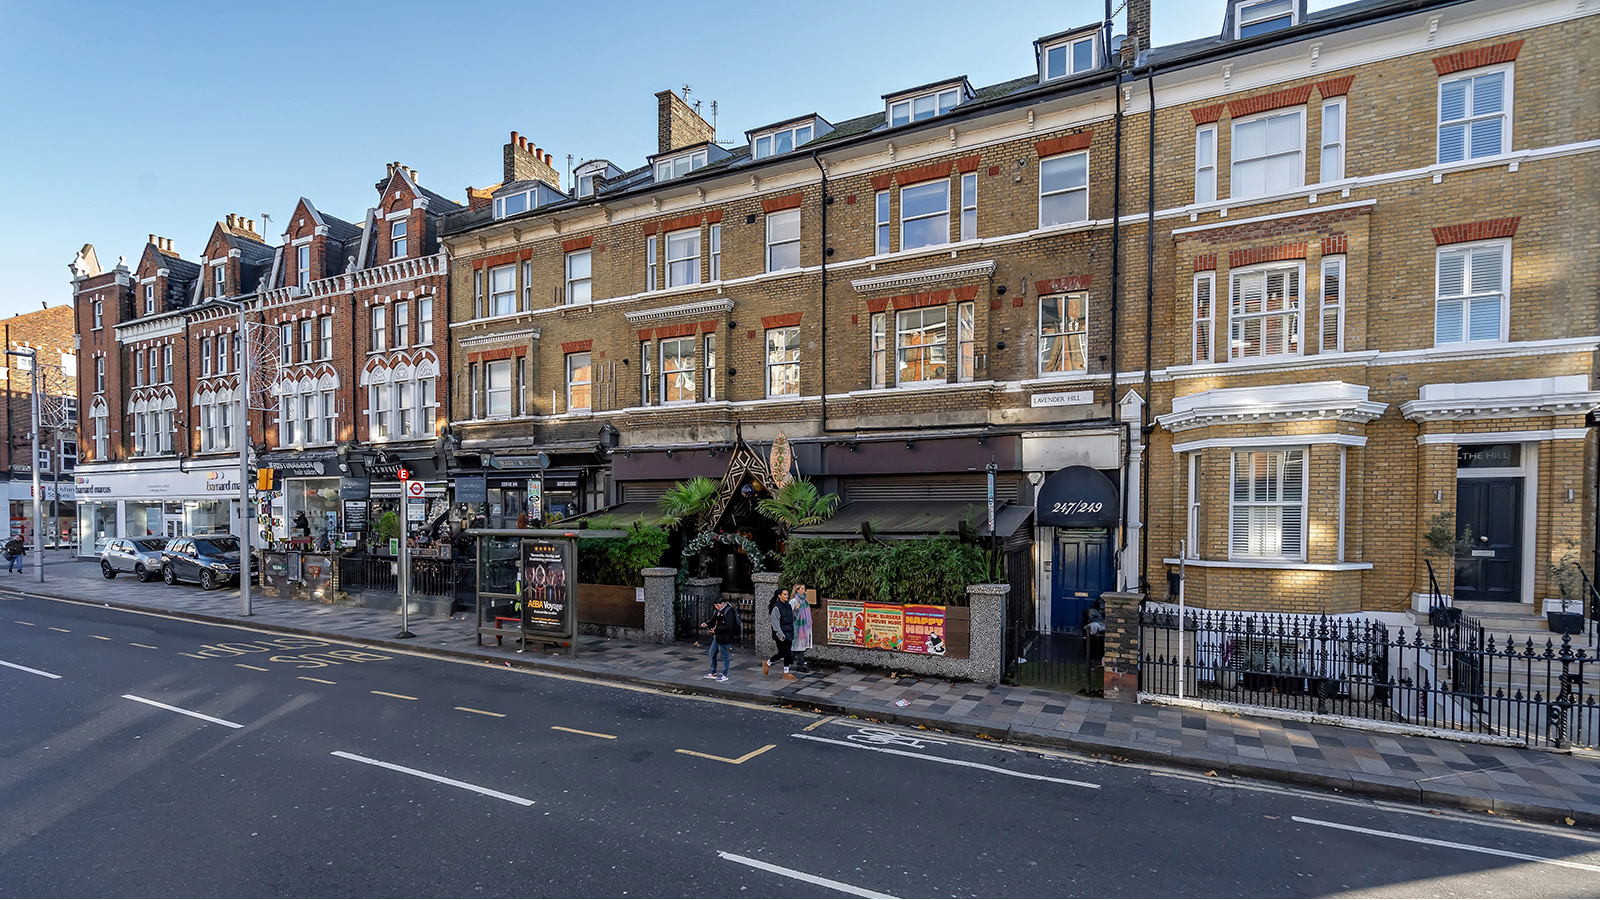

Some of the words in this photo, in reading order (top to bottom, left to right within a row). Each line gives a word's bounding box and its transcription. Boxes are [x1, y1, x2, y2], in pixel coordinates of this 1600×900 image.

[1033, 395, 1065, 404] LAVENDER
[1486, 451, 1509, 459] HILL
[401, 470, 407, 479] E
[94, 486, 111, 494] marcus
[206, 480, 231, 491] barnard
[1051, 500, 1103, 515] 247/249
[527, 599, 544, 609] ABBA
[543, 600, 563, 612] Voyage
[829, 611, 853, 619] TAPAS
[829, 618, 853, 627] FEAST
[905, 616, 944, 626] HAPPY
[905, 624, 944, 636] HOUR
[269, 650, 393, 669] BUS
